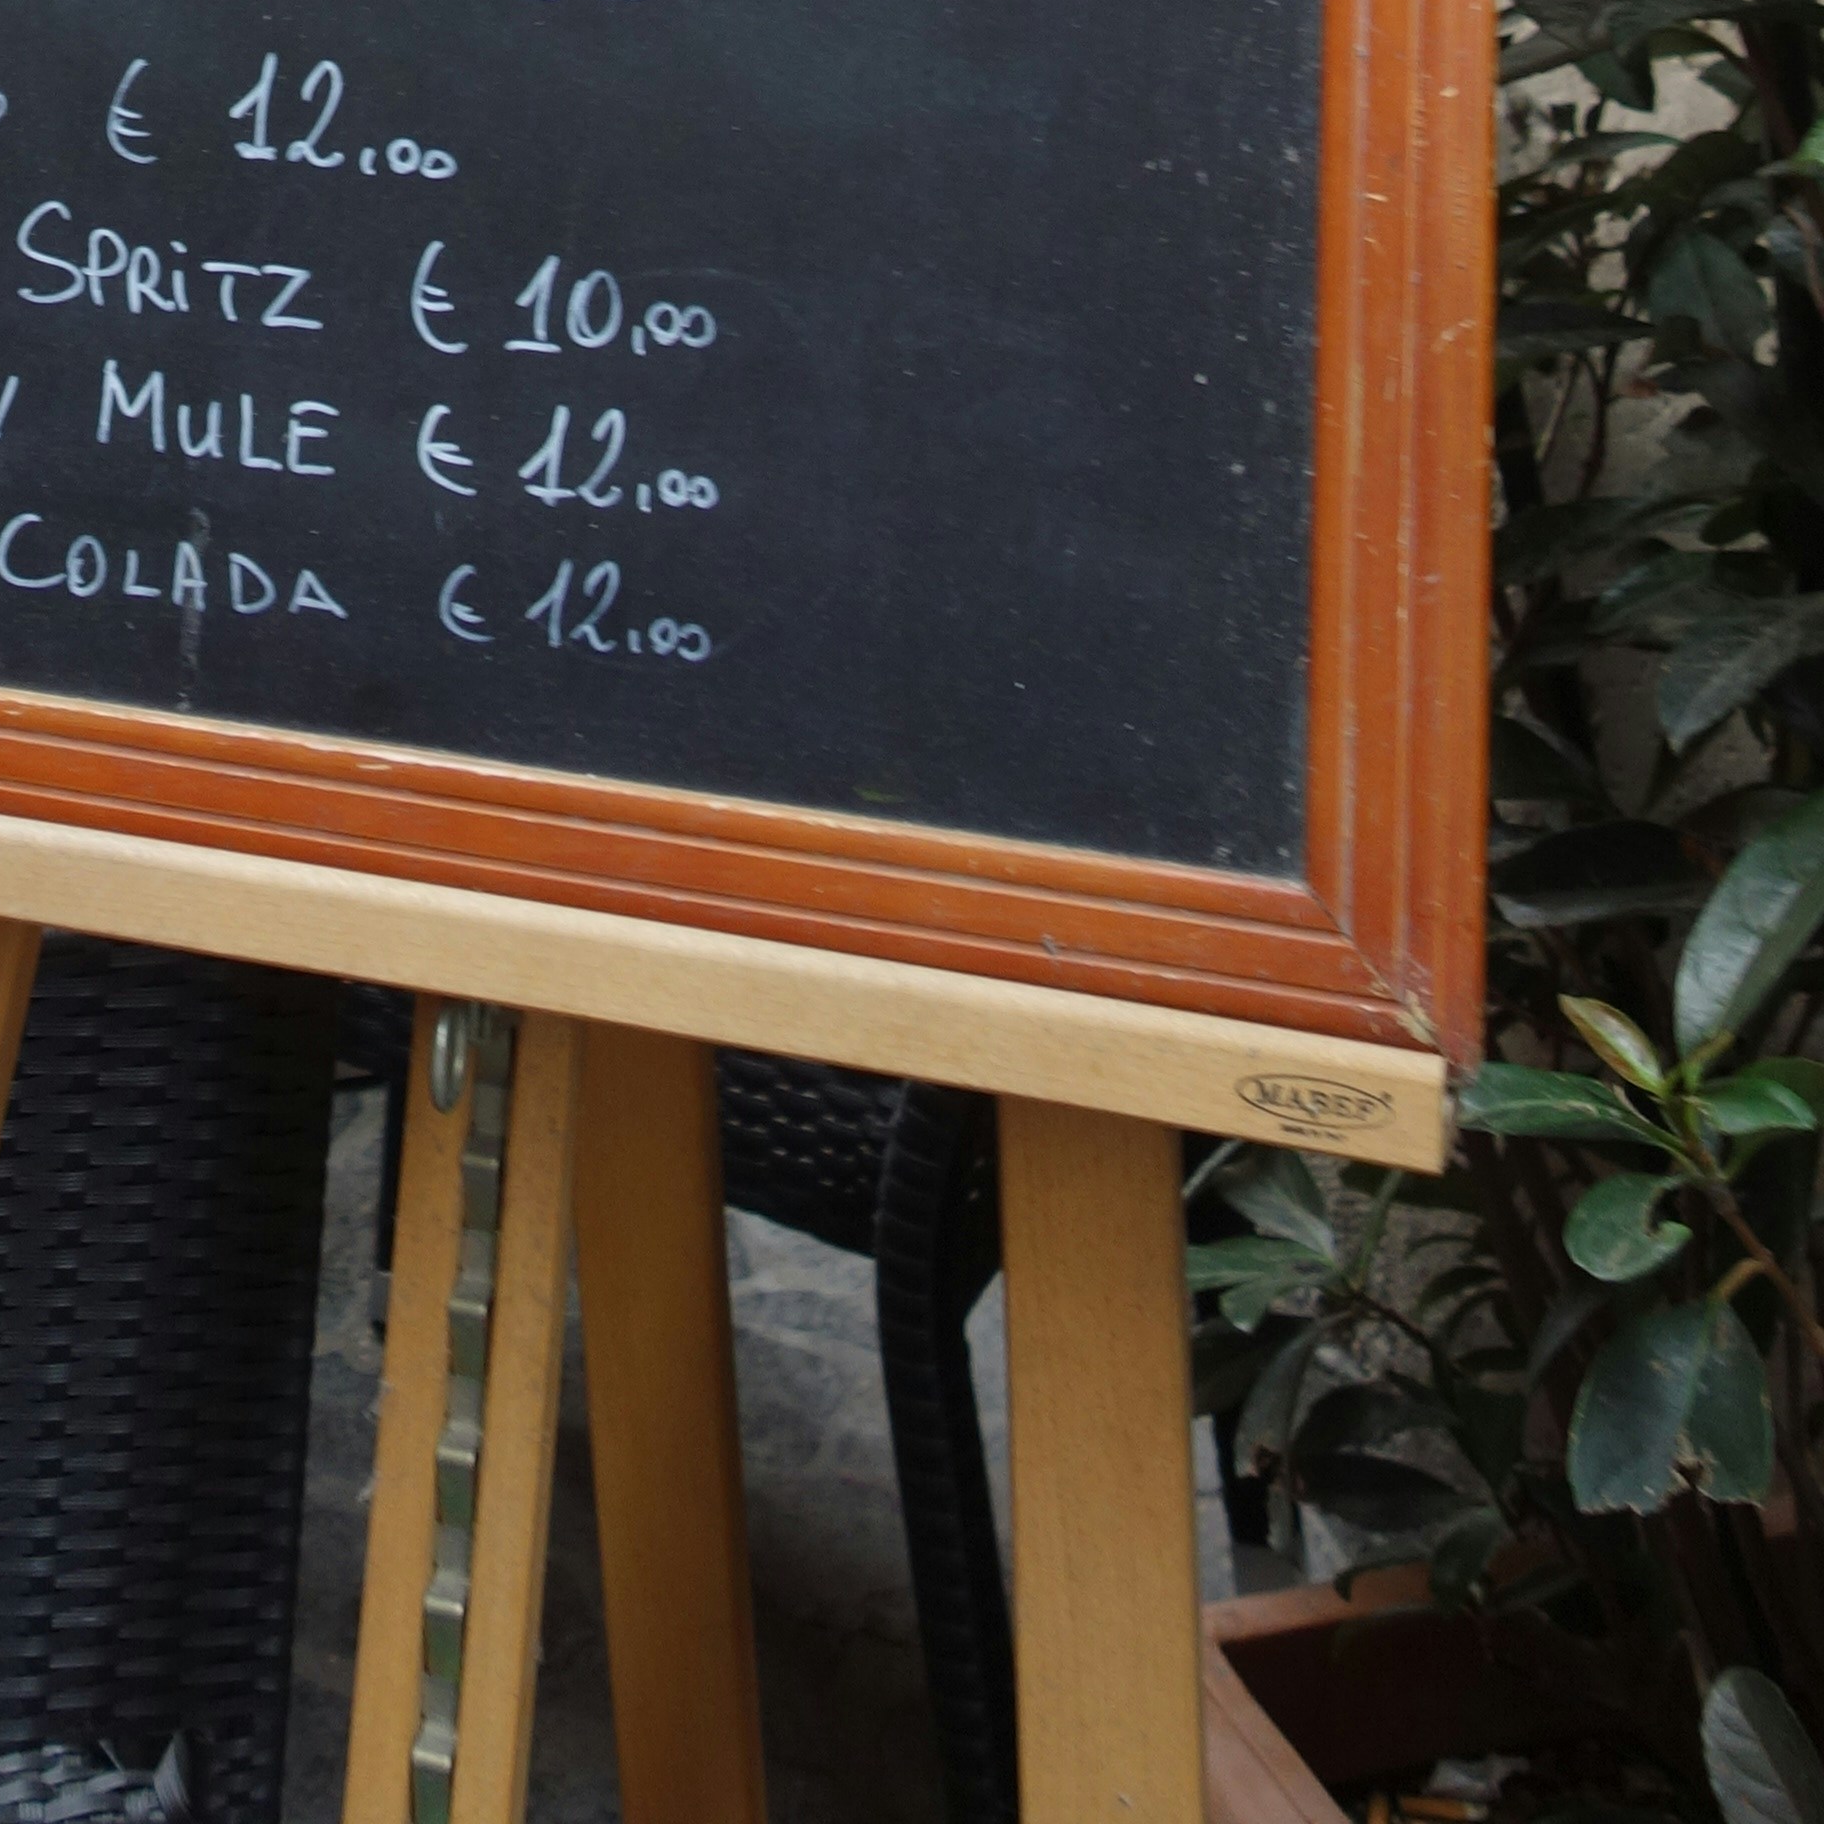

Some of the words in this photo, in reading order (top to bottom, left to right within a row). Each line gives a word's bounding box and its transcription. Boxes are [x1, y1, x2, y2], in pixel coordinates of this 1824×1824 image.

[107, 58, 156, 164] €
[411, 240, 468, 354] €
[417, 404, 476, 496] €
[439, 564, 492, 642] €
